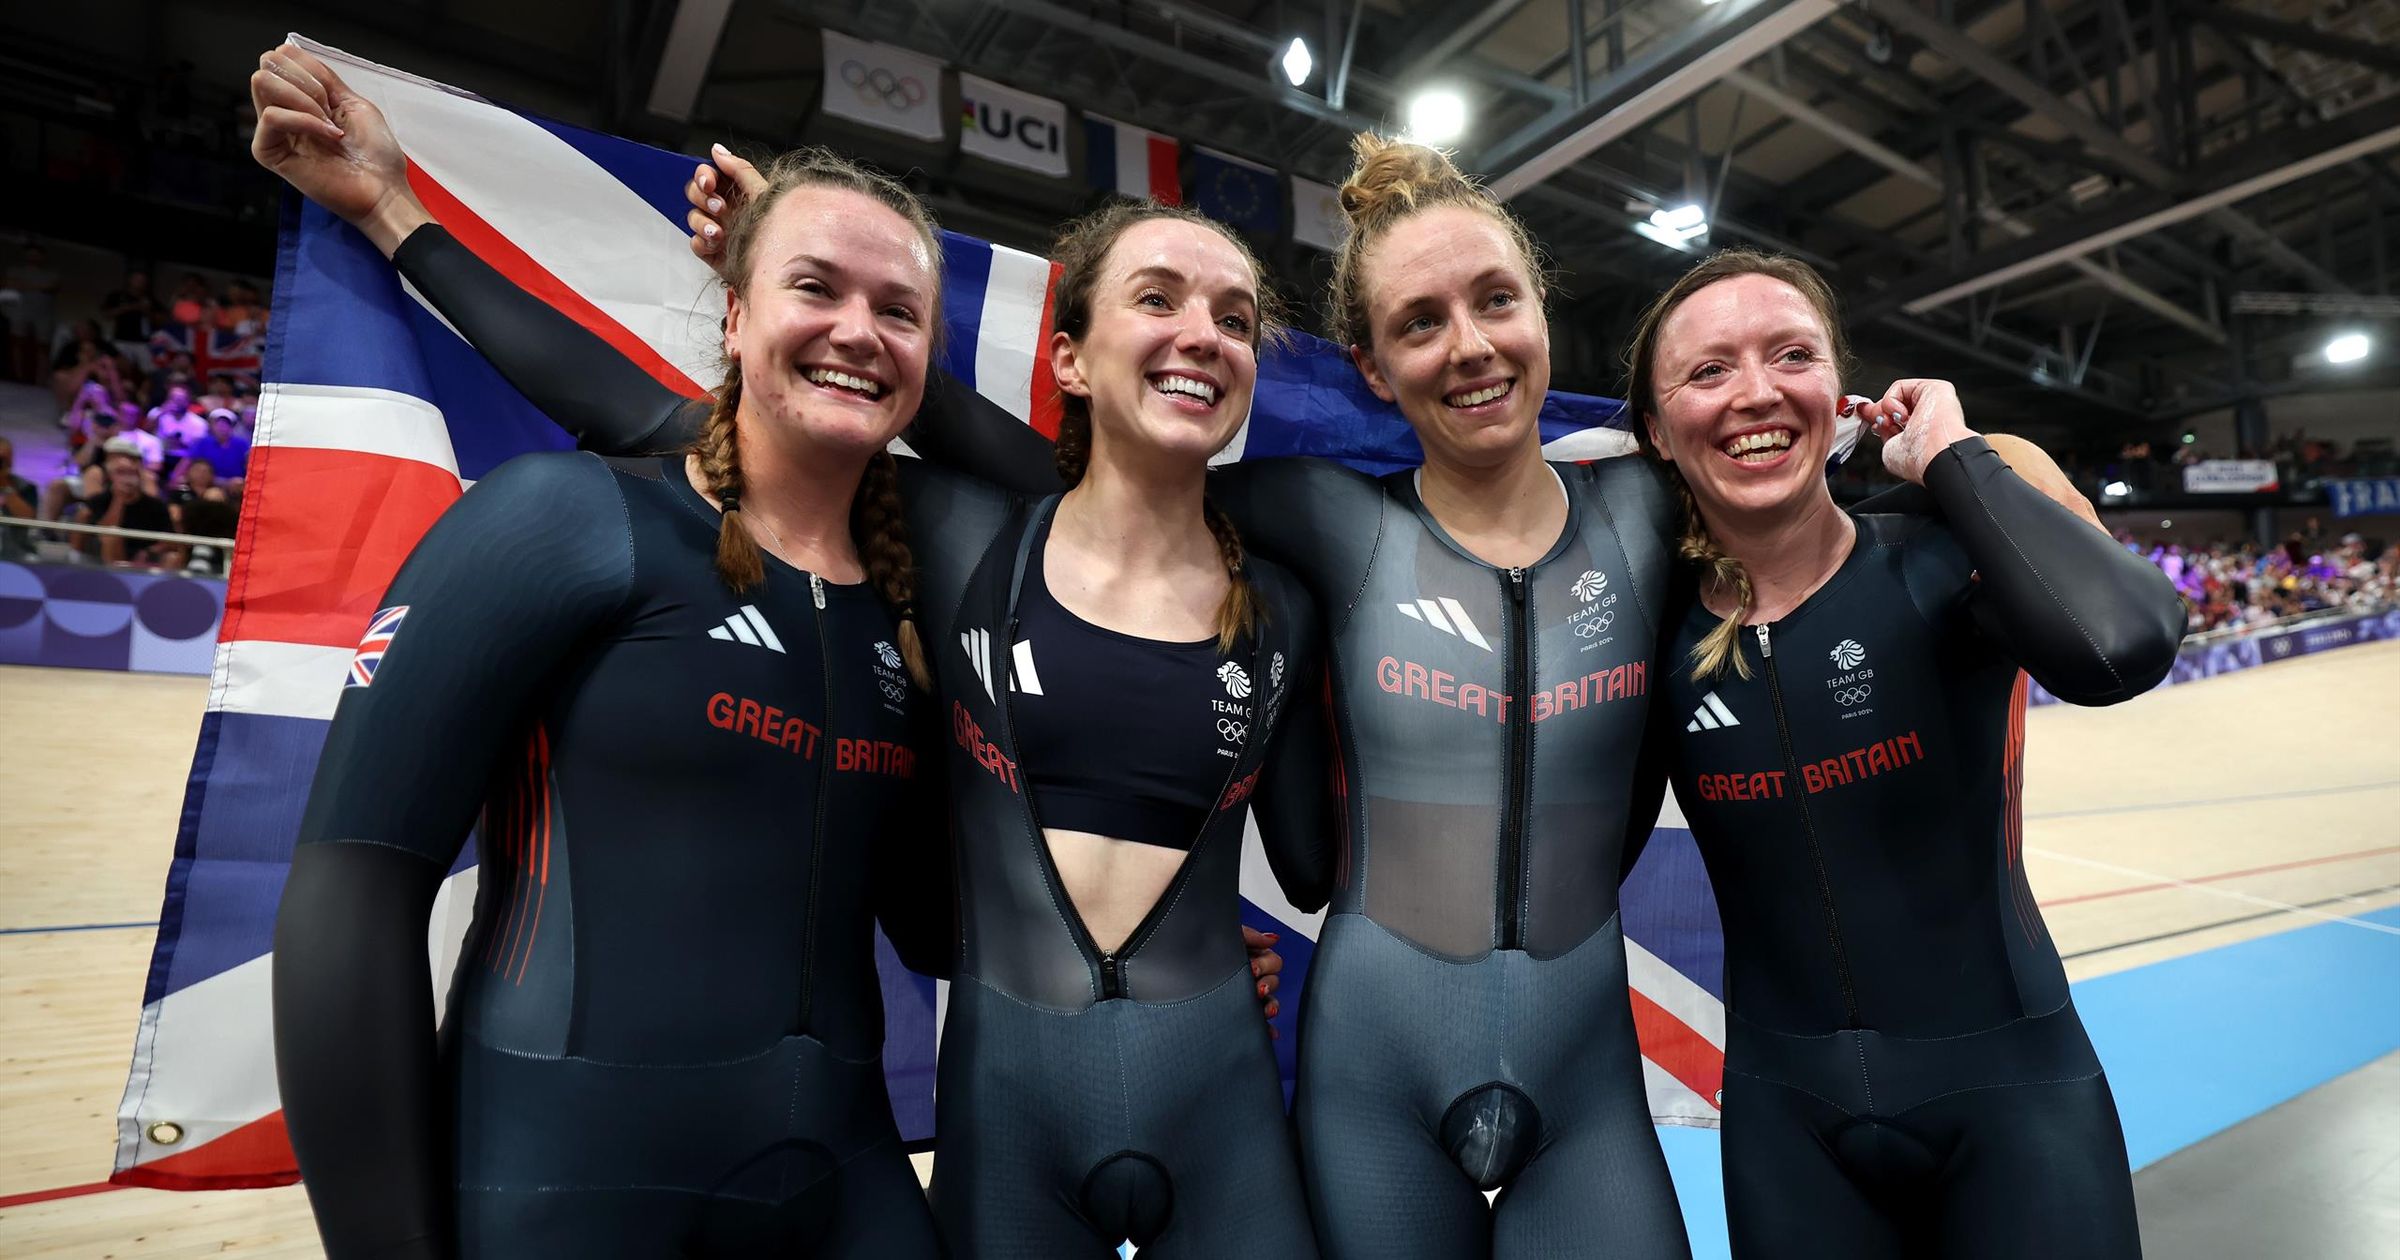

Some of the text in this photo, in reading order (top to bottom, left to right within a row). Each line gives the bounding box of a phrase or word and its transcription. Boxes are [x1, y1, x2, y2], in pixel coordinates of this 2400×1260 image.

[980, 103, 1059, 154] UCI
[2335, 480, 2400, 517] FRA
[1566, 593, 1617, 625] TEAM GB
[872, 664, 897, 681] TEAM
[1376, 655, 1647, 725] GREAT BRITAIN
[1827, 668, 1874, 689] TEAM GB
[706, 692, 822, 761] GREAT
[1211, 699, 1243, 716] TEAM
[952, 698, 1018, 794] GREAT
[1698, 731, 1925, 801] GREAT BRITAIN
